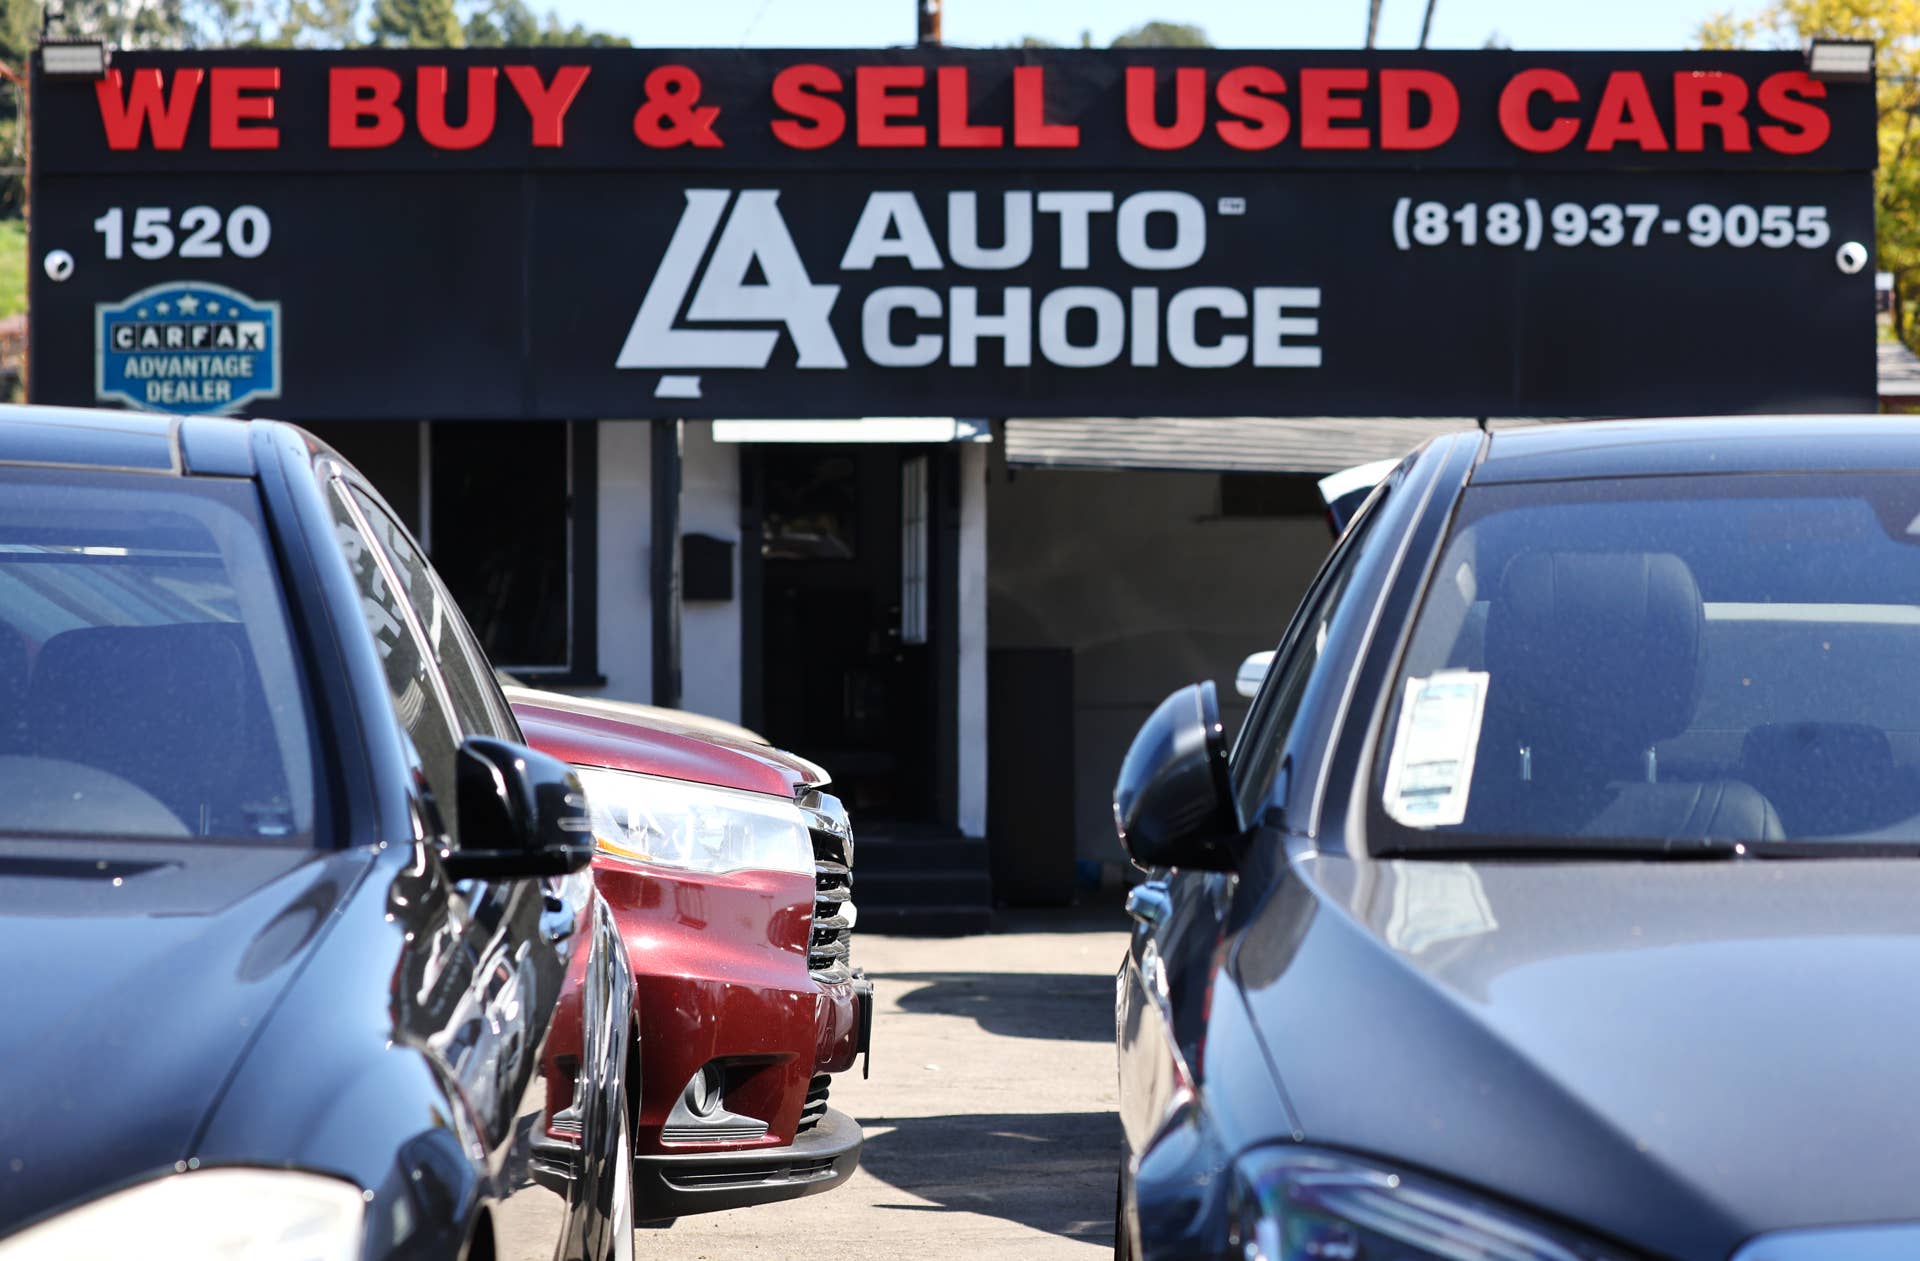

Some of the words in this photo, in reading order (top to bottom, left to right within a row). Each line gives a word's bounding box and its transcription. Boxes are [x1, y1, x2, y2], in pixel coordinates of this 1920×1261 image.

[97, 68, 281, 150] WE
[329, 66, 591, 149] BUY
[634, 66, 723, 148] &
[771, 65, 1080, 149] SELL
[1125, 67, 1460, 150] USED
[1498, 69, 1831, 154] CARS
[94, 206, 270, 259] 1520
[841, 191, 1206, 270] AUTO
[1393, 198, 1543, 251] (818)
[1551, 203, 1830, 248] 937-9055
[113, 324, 263, 350] CARFAX
[862, 287, 1322, 368] CHOICE
[124, 355, 253, 379] ADVANTAGE
[146, 379, 232, 404] DEALER
